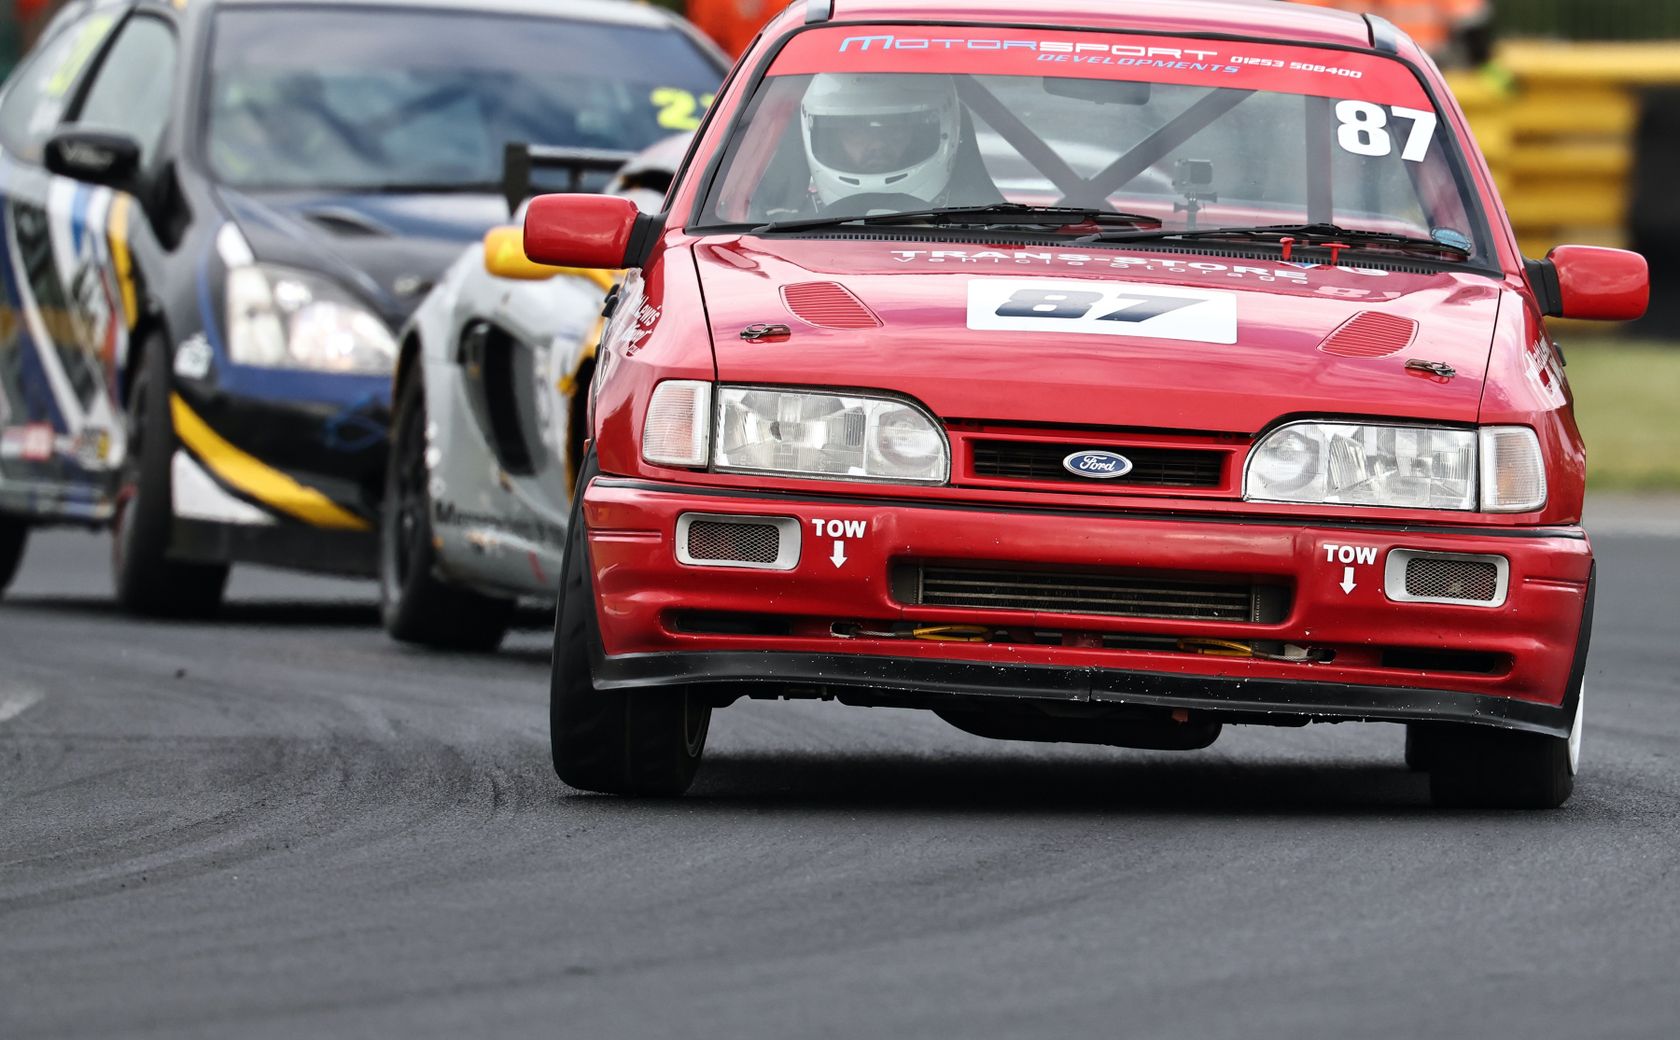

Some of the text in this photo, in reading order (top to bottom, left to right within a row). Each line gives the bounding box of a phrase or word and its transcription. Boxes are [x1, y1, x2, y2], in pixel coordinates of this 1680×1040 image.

[1036, 53, 1239, 74] DEVELOPMENTS
[1230, 55, 1363, 79] 01253 508400
[1334, 99, 1437, 163] 87
[890, 250, 1309, 281] TRANS-STORE
[994, 289, 1209, 323] 87
[1079, 455, 1116, 472] Ford
[811, 518, 867, 538] TOW
[1323, 544, 1378, 565] TOW
